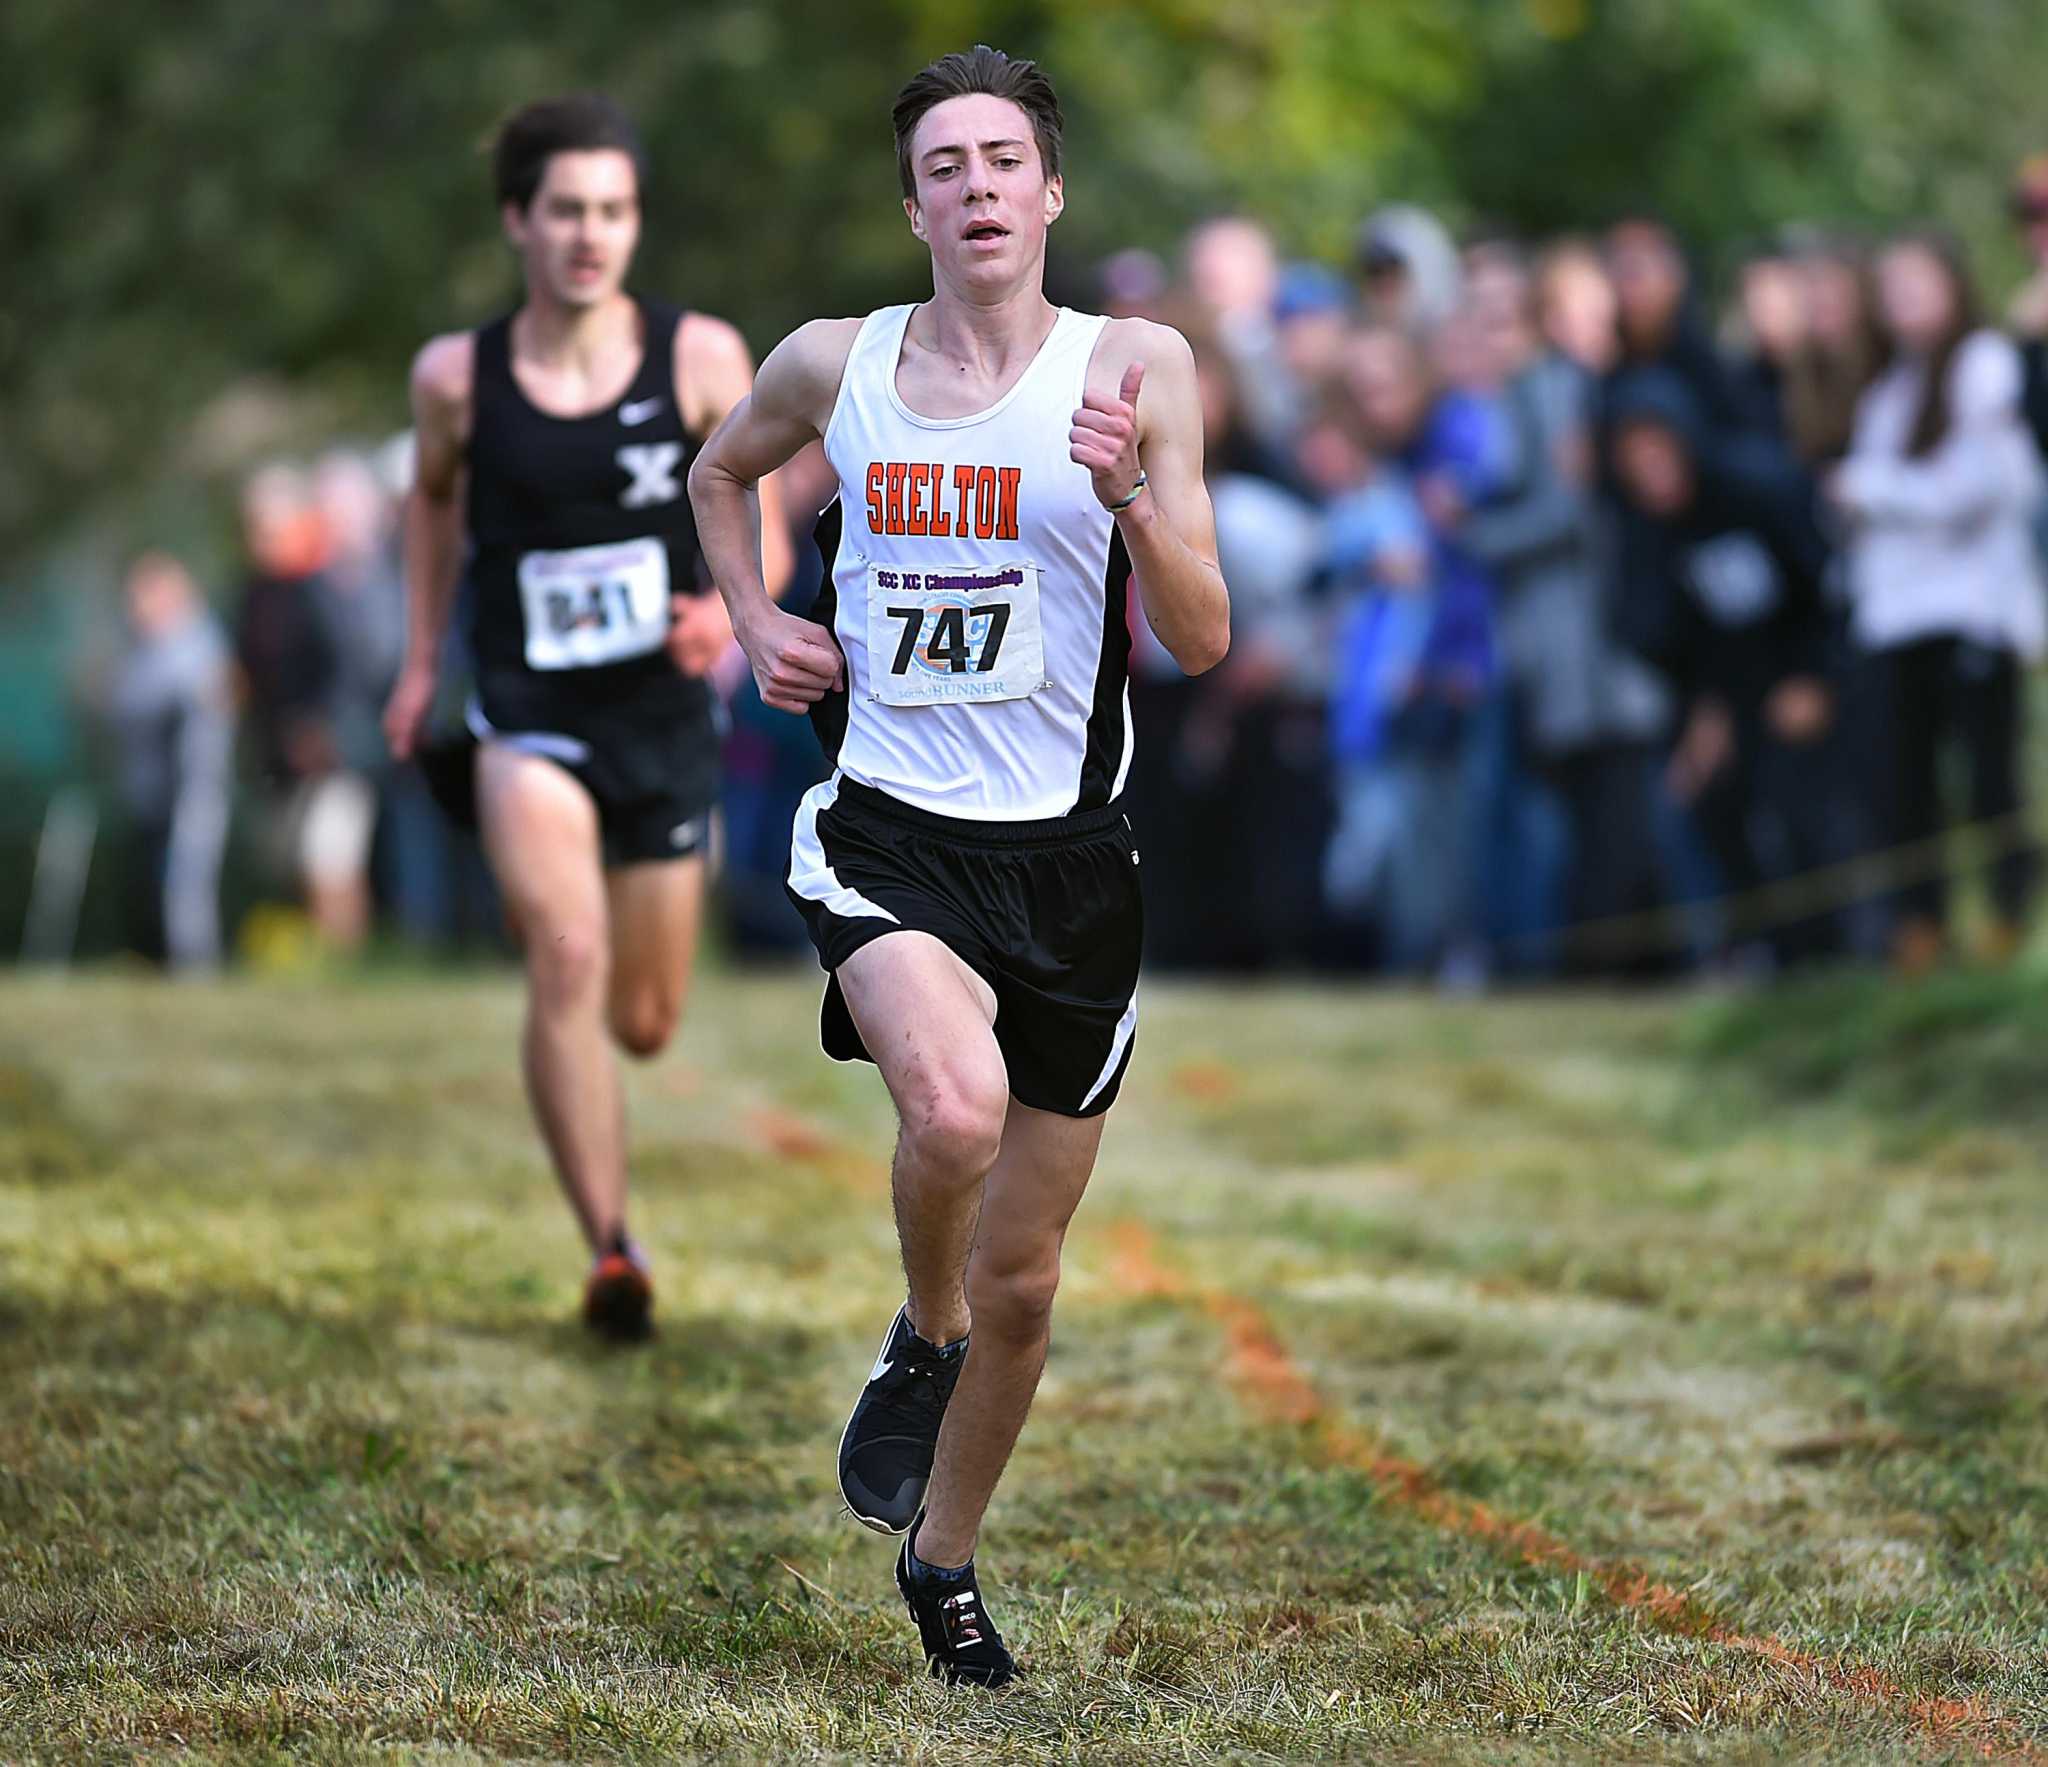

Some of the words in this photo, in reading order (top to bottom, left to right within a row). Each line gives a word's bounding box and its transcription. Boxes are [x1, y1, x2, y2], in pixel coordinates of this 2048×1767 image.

[616, 441, 684, 508] X
[866, 462, 1021, 540] SHELTON
[877, 570, 898, 590] SCC
[902, 573, 921, 590] XC
[924, 569, 1024, 592] Championship
[886, 603, 1011, 675] 747
